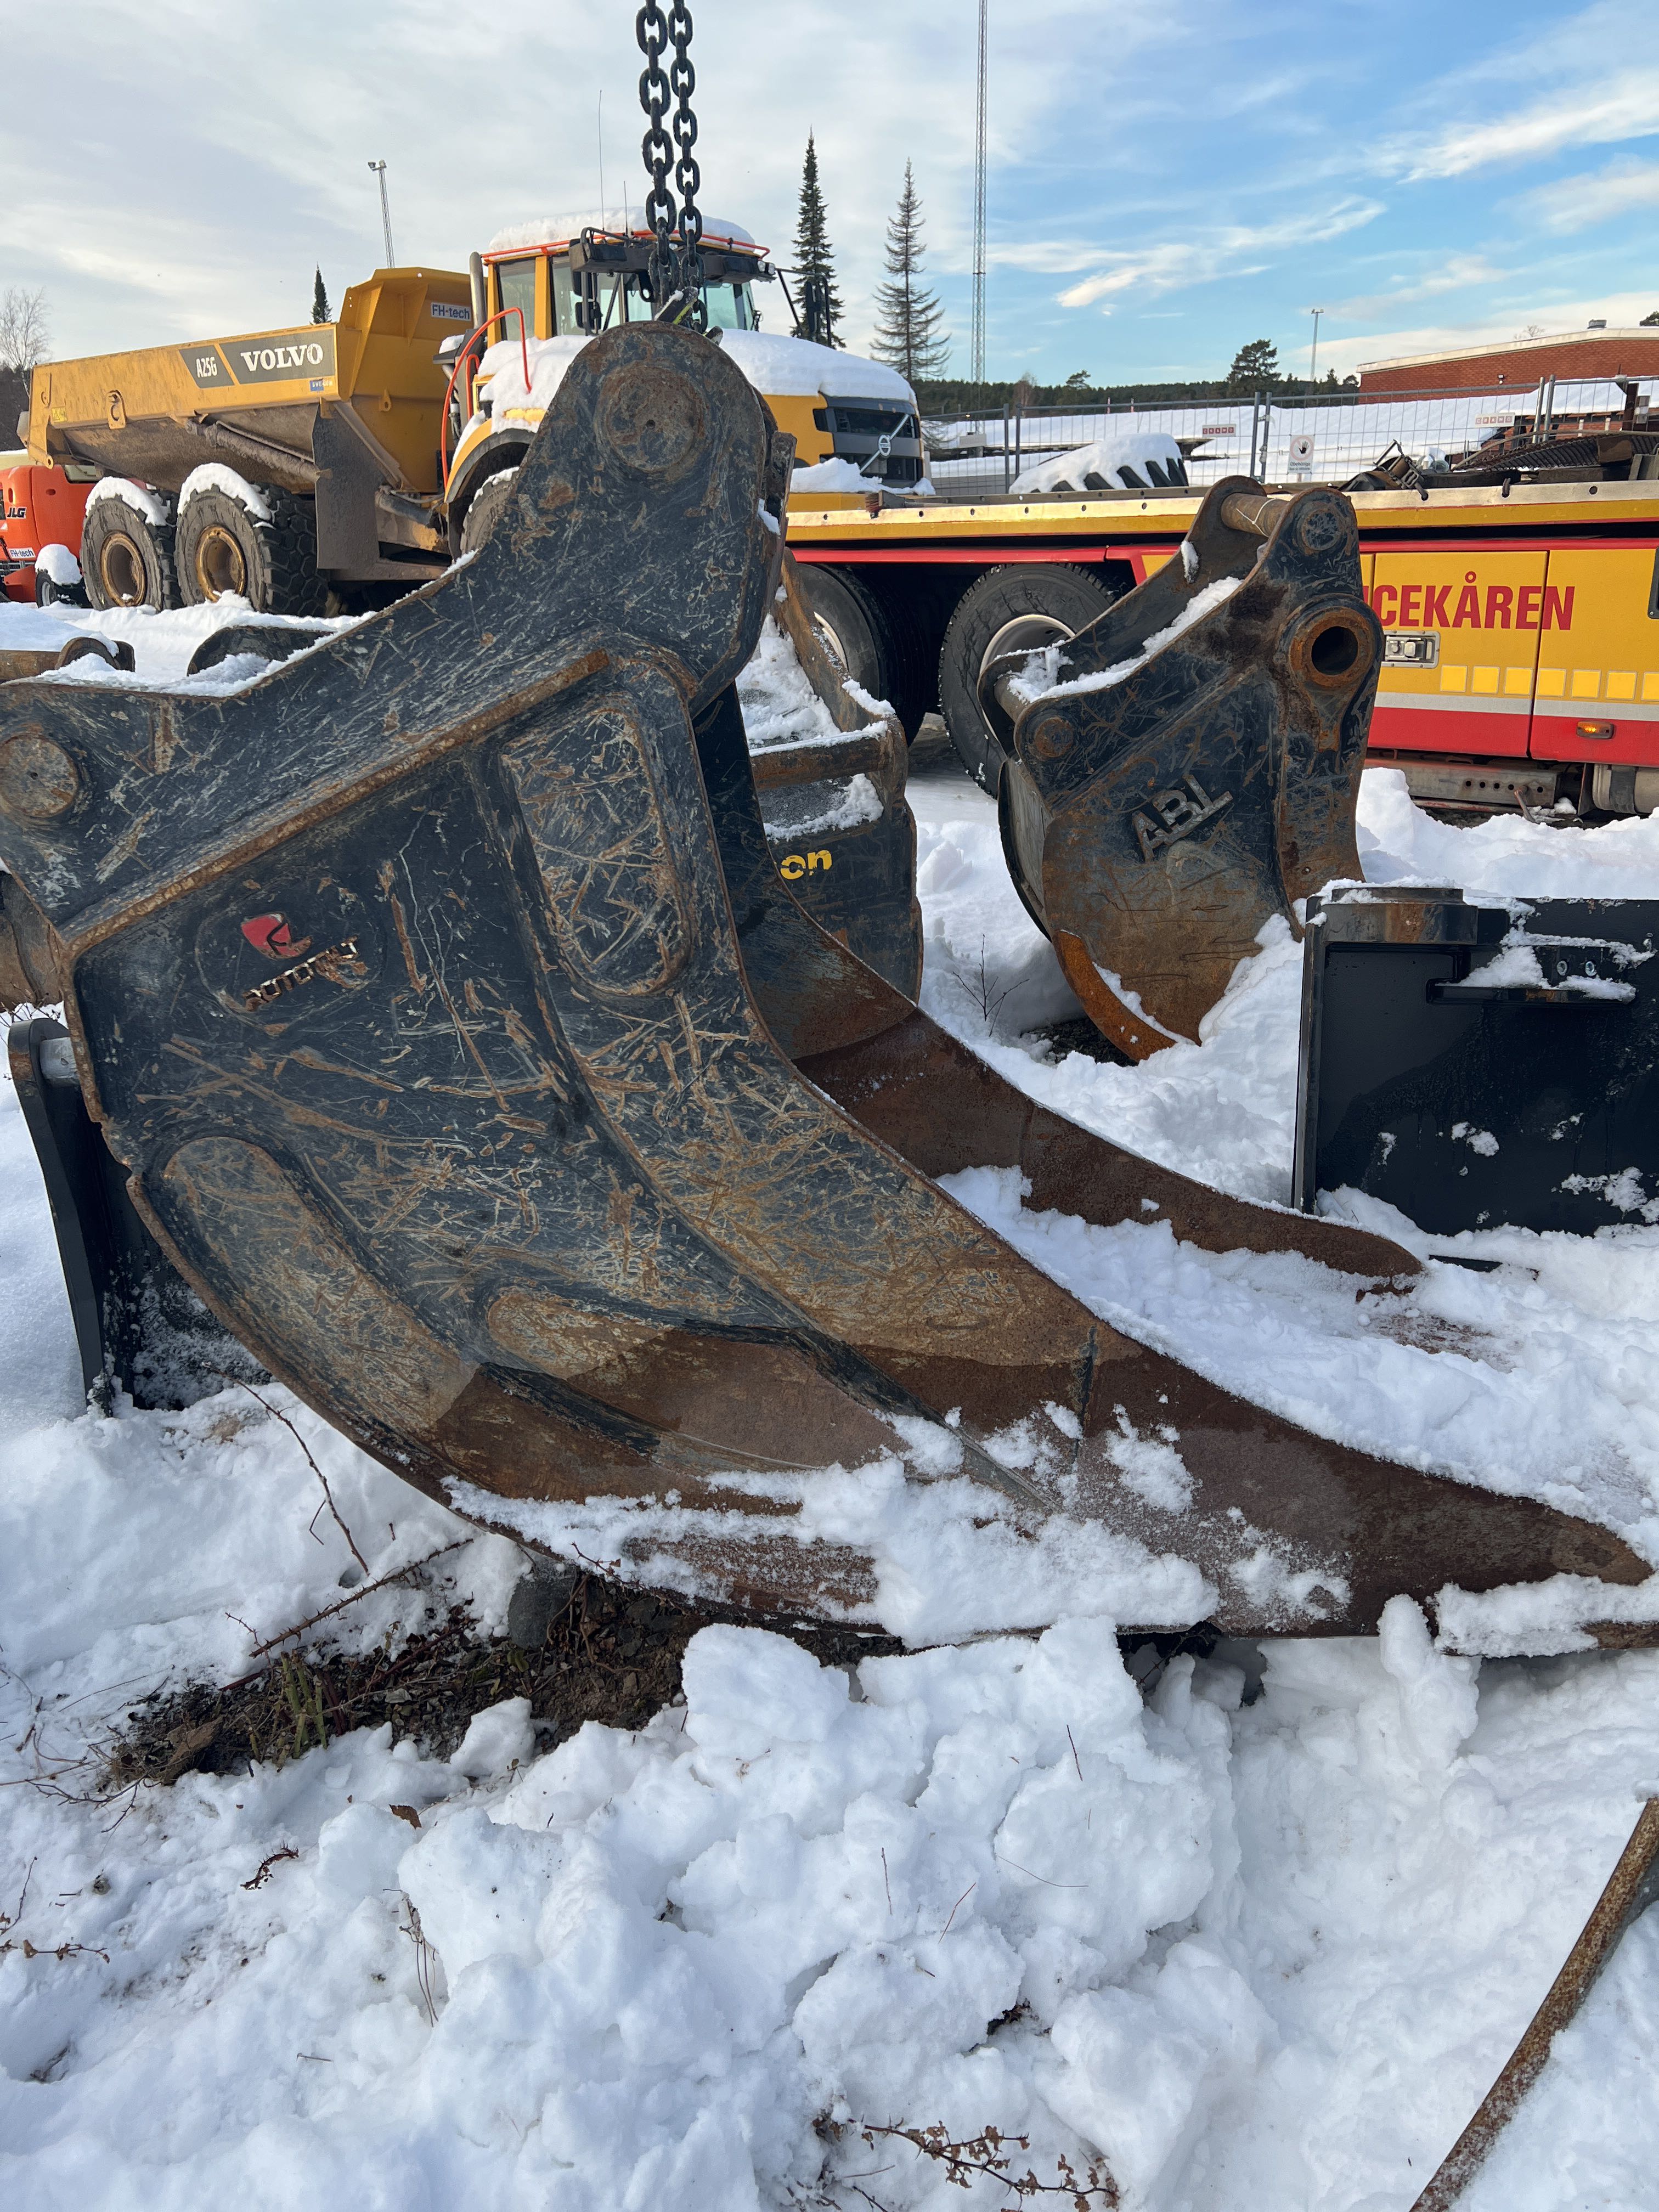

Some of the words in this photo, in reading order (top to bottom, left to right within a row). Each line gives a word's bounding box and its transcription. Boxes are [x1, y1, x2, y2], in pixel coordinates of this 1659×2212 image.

[432, 303, 470, 320] FH-tech
[196, 356, 218, 378] A25G
[240, 343, 324, 372] VOLVO
[1476, 416, 1512, 424] CRAMO
[7, 507, 26, 518] JLG
[10, 549, 34, 557] FH-tech
[1363, 571, 1575, 630] CEKÅREN
[1132, 774, 1233, 864] ABL
[780, 849, 832, 880] on
